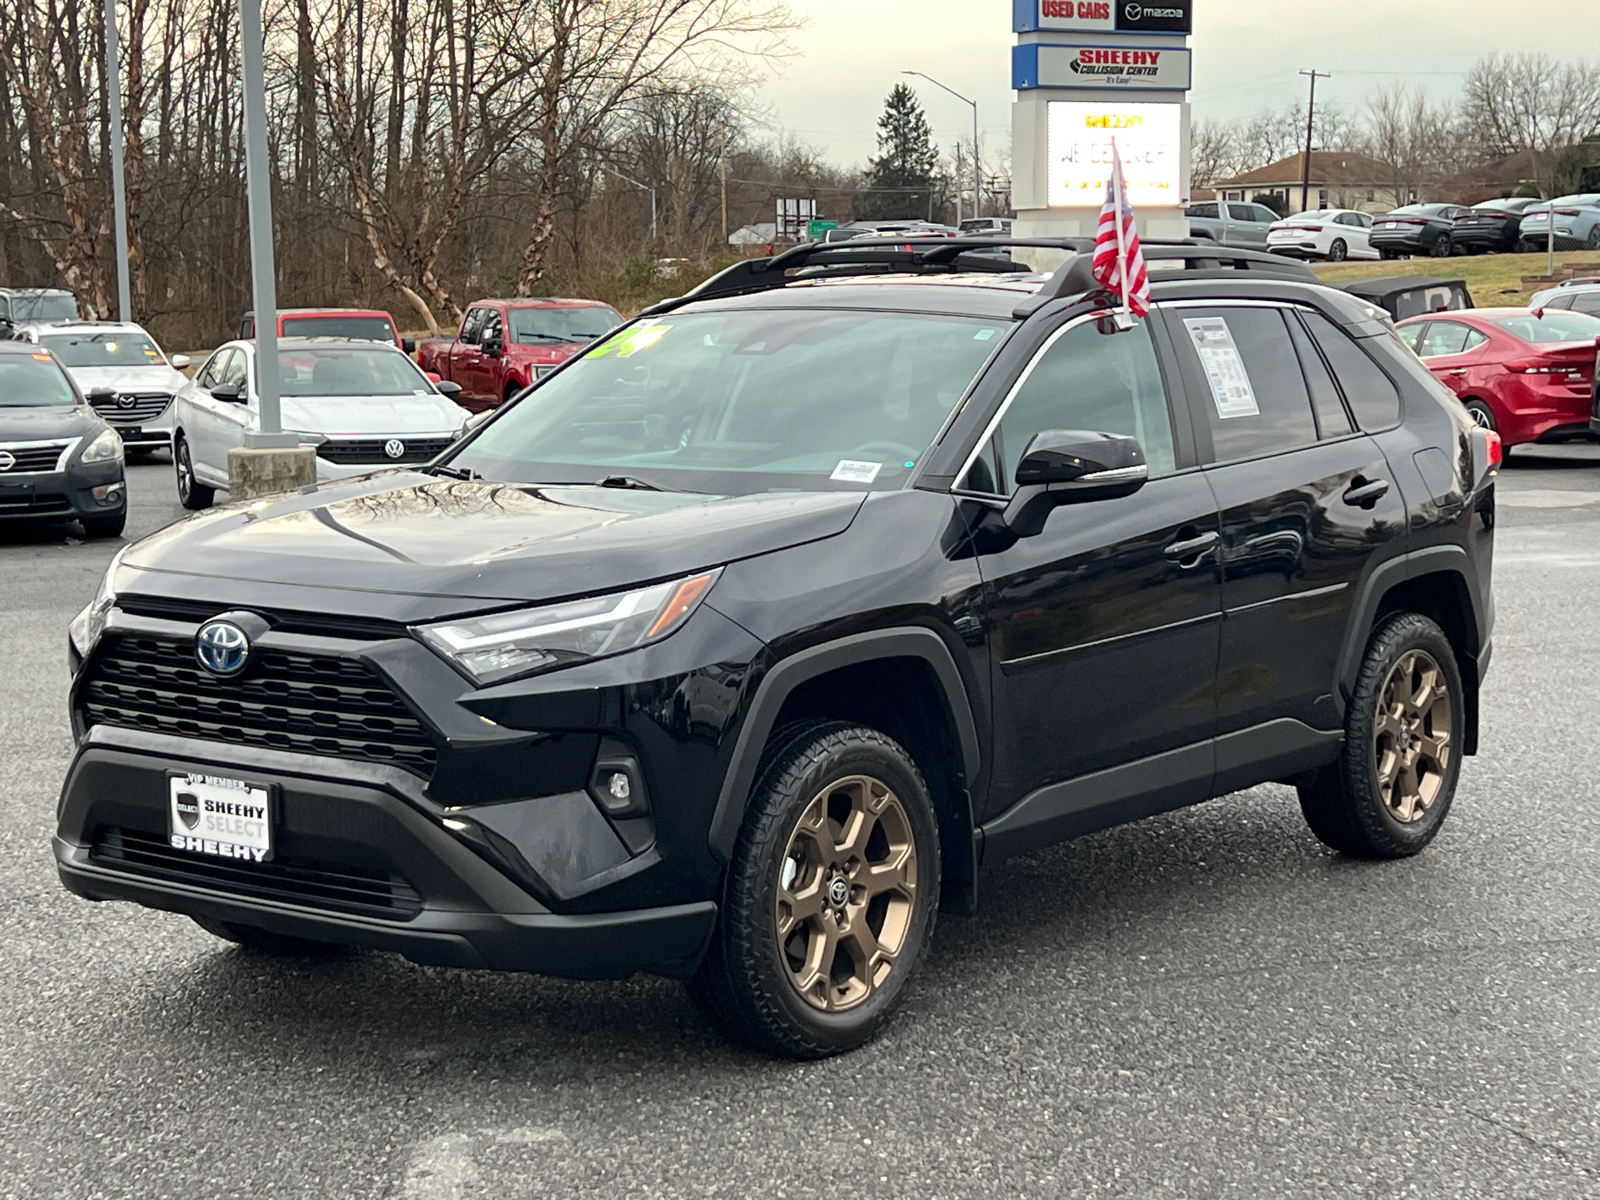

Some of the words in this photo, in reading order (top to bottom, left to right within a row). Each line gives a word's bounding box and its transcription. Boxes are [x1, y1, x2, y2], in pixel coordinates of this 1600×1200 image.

[1042, 0, 1074, 18] USED
[1077, 1, 1110, 20] CARS
[1143, 8, 1184, 18] mazda
[1079, 49, 1161, 65] SHEEHY
[1080, 65, 1125, 75] COLLISION
[1126, 66, 1159, 76] CENTER
[1106, 76, 1115, 84] It's
[1116, 76, 1132, 85] Easy!
[188, 773, 203, 784] VIP
[204, 775, 245, 791] MEMBER
[204, 799, 265, 819] SHEEHY
[206, 814, 266, 839] SELECT
[171, 834, 267, 863] SHEEHY
